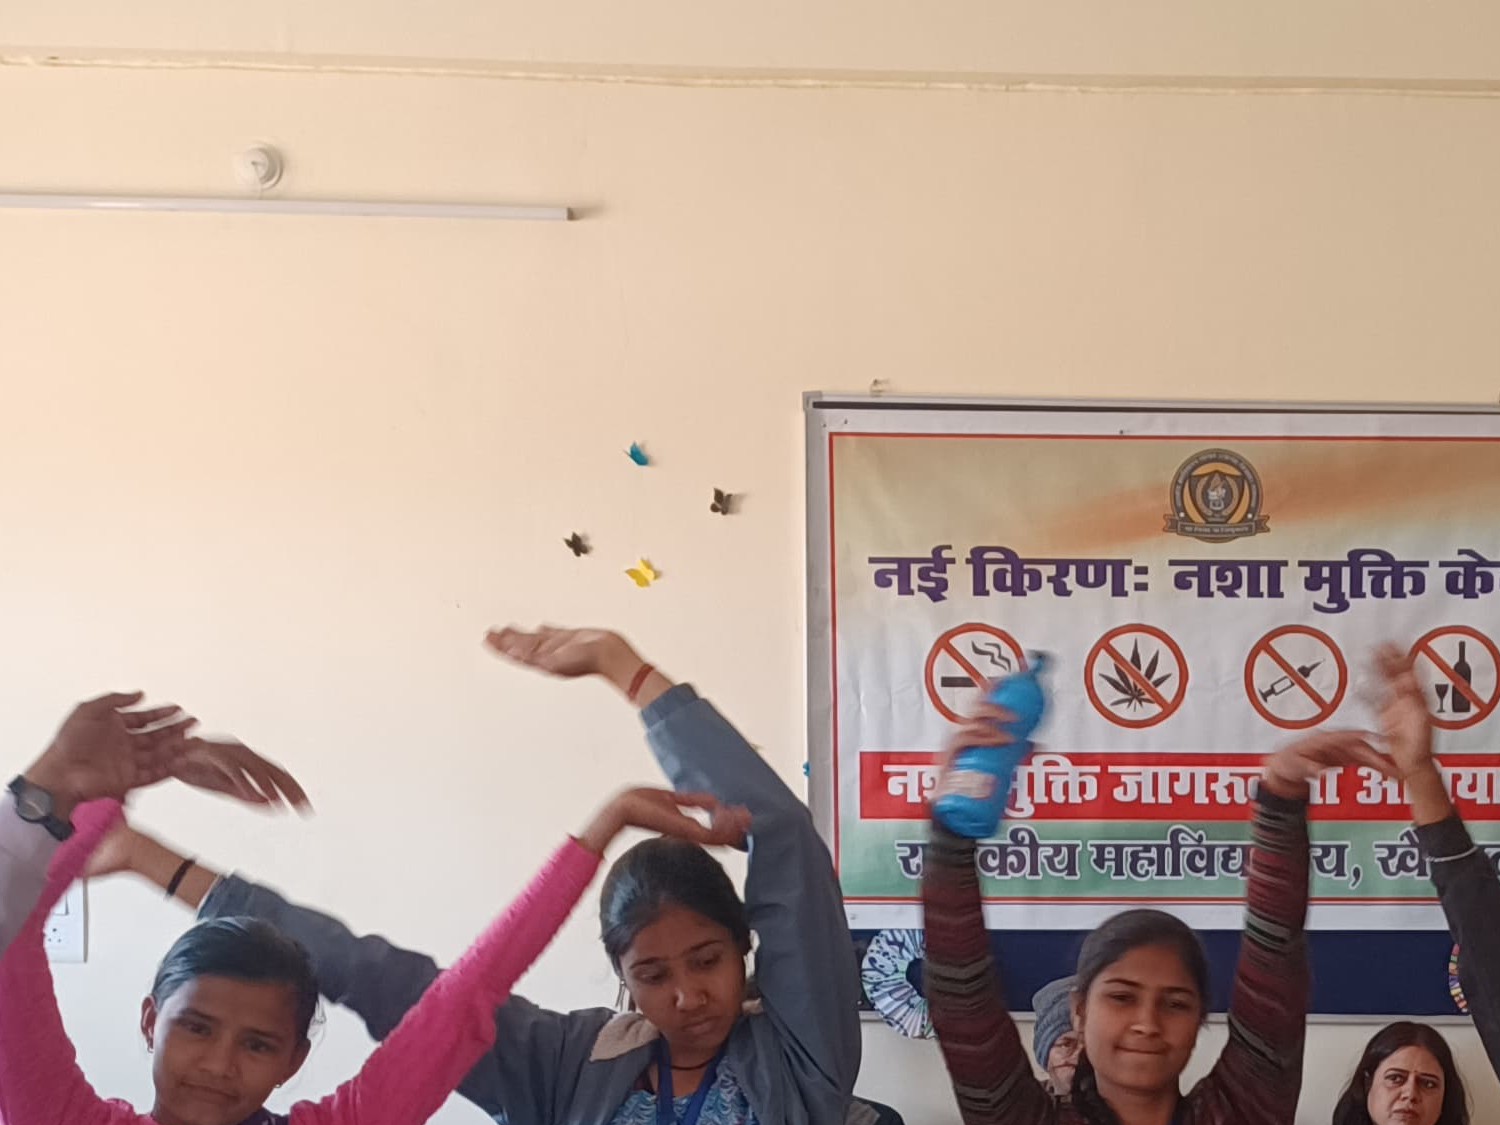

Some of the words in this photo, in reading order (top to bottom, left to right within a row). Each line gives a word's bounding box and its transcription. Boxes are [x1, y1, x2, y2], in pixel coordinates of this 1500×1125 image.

[868, 544, 956, 603] नई
[1167, 559, 1289, 599] नशा
[1297, 548, 1430, 614] मुक्ति
[895, 825, 1081, 878] रकीय
